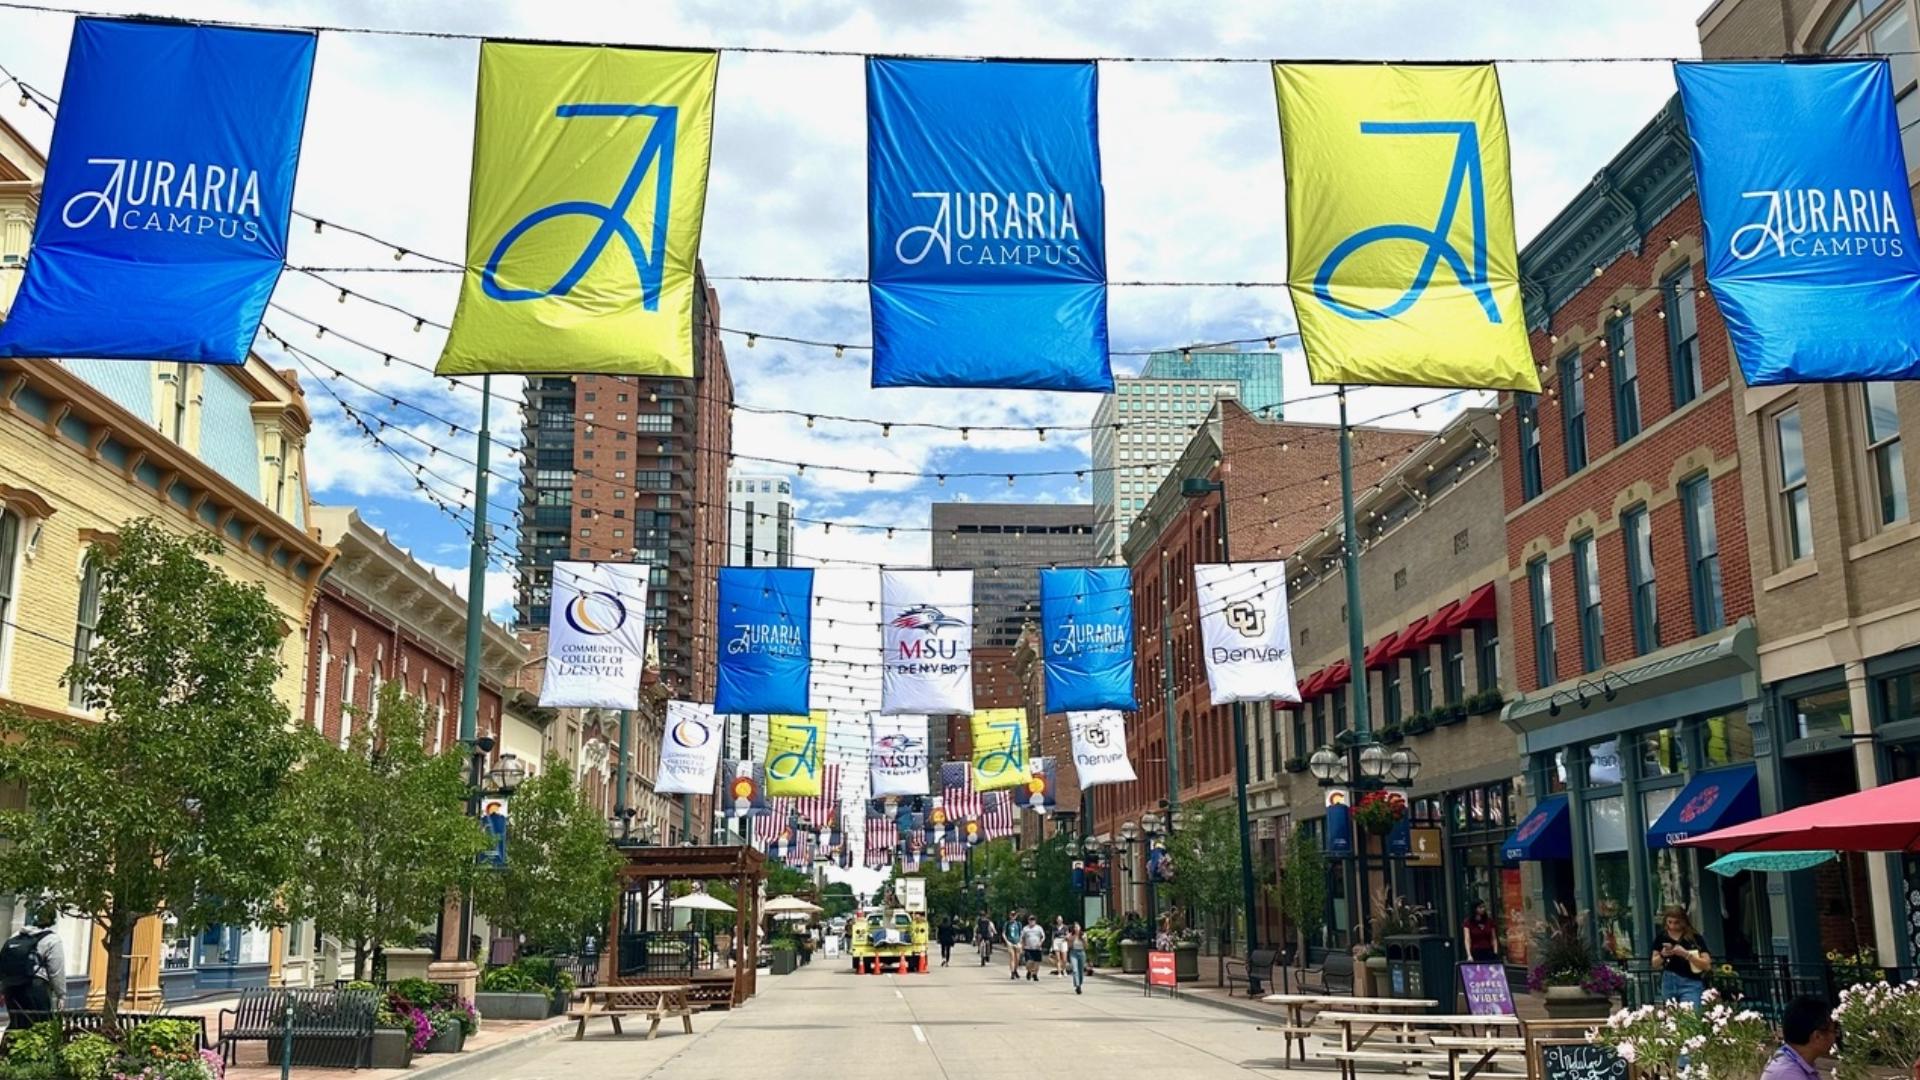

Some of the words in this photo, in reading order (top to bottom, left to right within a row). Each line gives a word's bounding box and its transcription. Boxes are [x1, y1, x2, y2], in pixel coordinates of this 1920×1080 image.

[62, 158, 262, 230] AURARIA
[122, 209, 260, 242] CAMPUS
[895, 191, 1080, 265] AURARIA
[1730, 188, 1901, 260] AURARIA
[957, 245, 1081, 265] CAMPUS
[1790, 237, 1904, 257] CAMPUS
[561, 644, 624, 654] COMMUNITY
[727, 624, 803, 655] AURARIA
[898, 638, 957, 660] MSU
[1053, 623, 1125, 655] AURARIA
[561, 654, 606, 664] COLLEGE
[609, 656, 623, 665] OF
[1211, 646, 1285, 665] Denver
[558, 663, 625, 678] DENVER
[897, 662, 958, 675] DENVER
[879, 754, 918, 768] MSU
[1472, 993, 1507, 1004] VIBES
